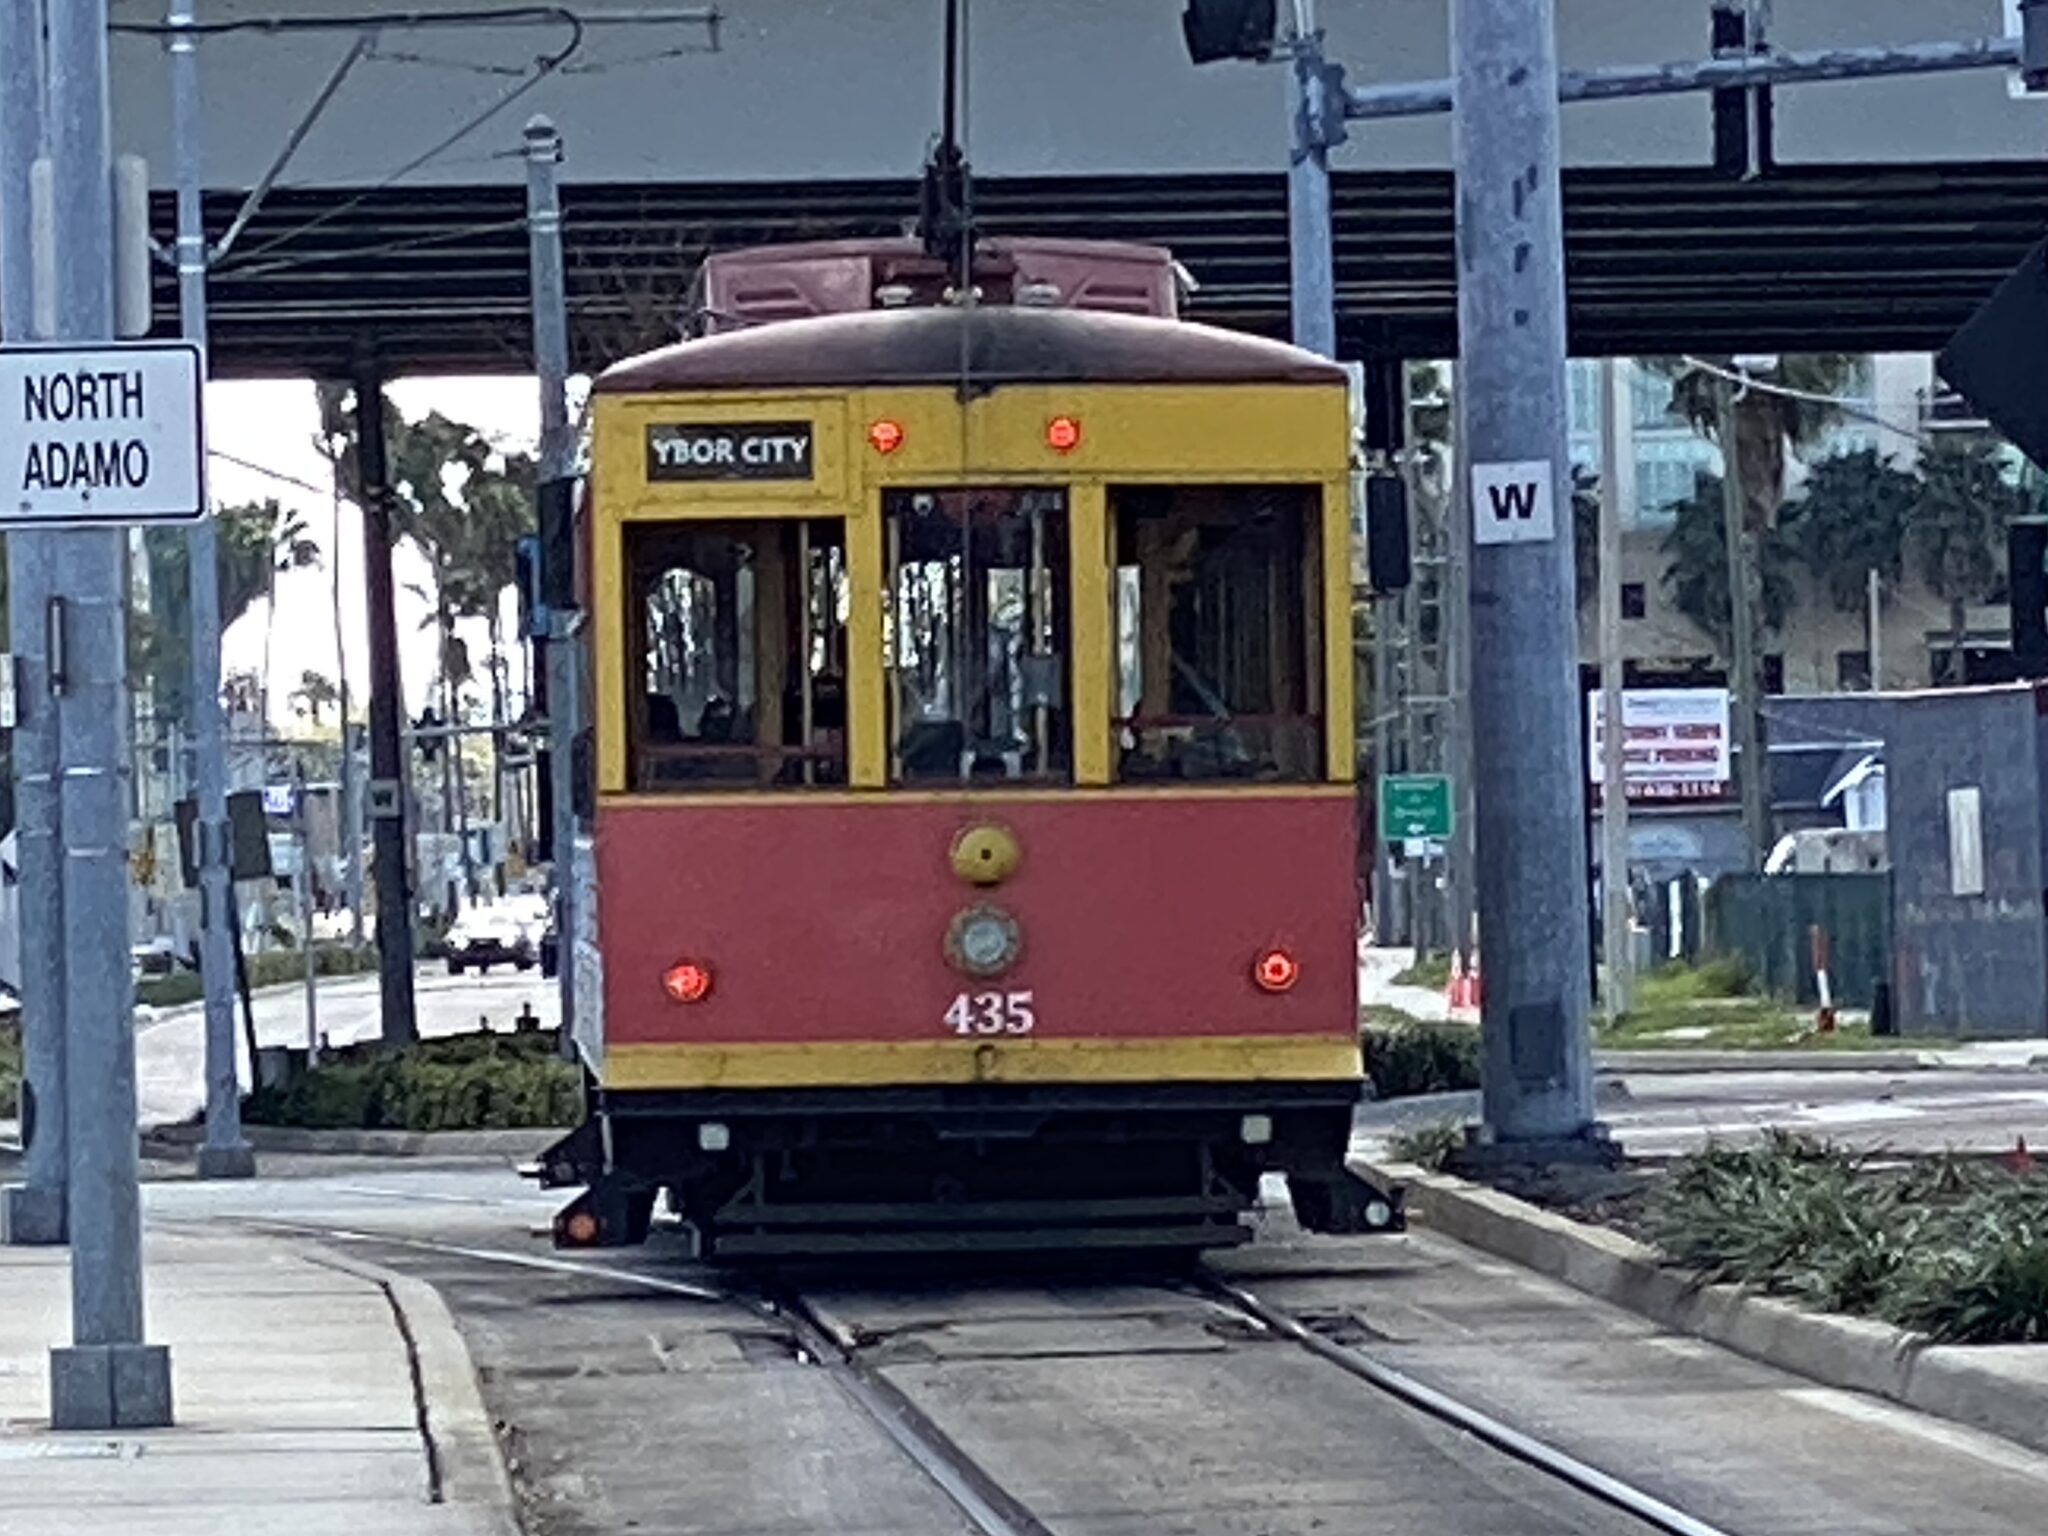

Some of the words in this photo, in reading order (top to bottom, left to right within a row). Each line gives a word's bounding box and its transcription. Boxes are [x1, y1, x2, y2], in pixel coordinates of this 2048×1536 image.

[24, 370, 144, 422] NORTH
[22, 439, 149, 490] ADAMO
[652, 438, 735, 465] YBOR
[741, 436, 808, 463] CITY
[1488, 482, 1537, 520] W
[943, 991, 1034, 1034] 435
